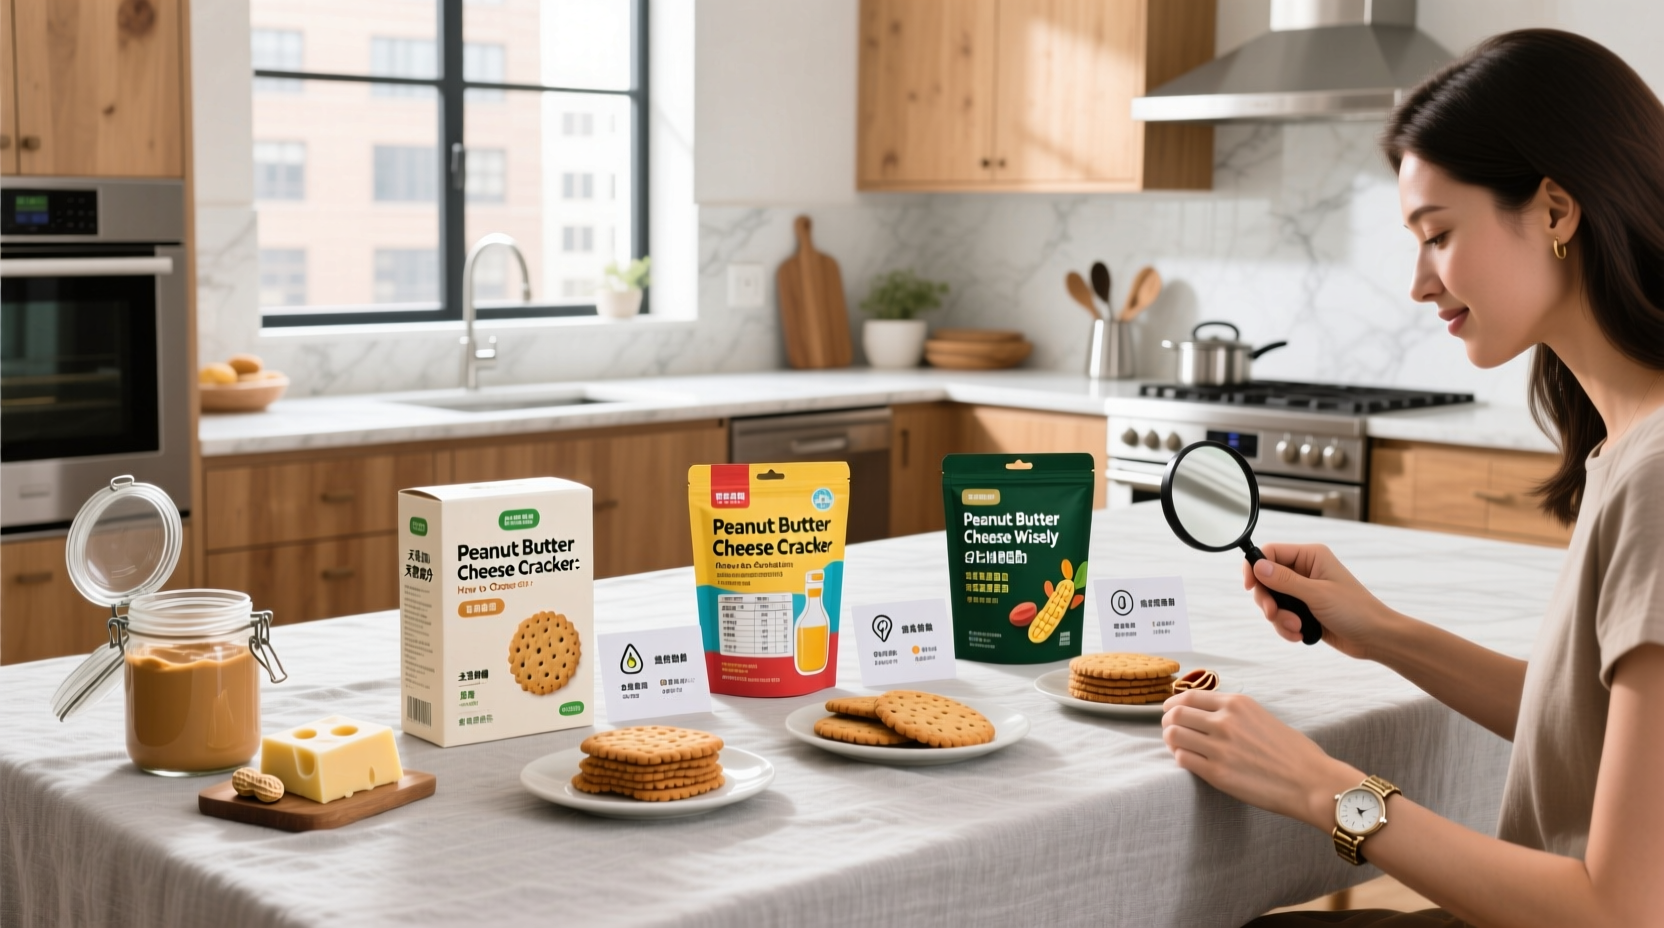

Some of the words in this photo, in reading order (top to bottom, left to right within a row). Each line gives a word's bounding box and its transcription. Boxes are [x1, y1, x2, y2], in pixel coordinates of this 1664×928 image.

[713, 518, 775, 536] Peanut
[778, 517, 832, 533] Butter
[963, 512, 1013, 526] Peanut
[1015, 512, 1060, 526] Butter
[712, 538, 774, 557] Cheese
[777, 536, 833, 555] Cracker
[963, 529, 1012, 544] Cheese
[1014, 529, 1059, 548] Wisely
[457, 541, 519, 562] Peanut
[522, 537, 575, 556] Butter
[457, 564, 515, 580] Cheese
